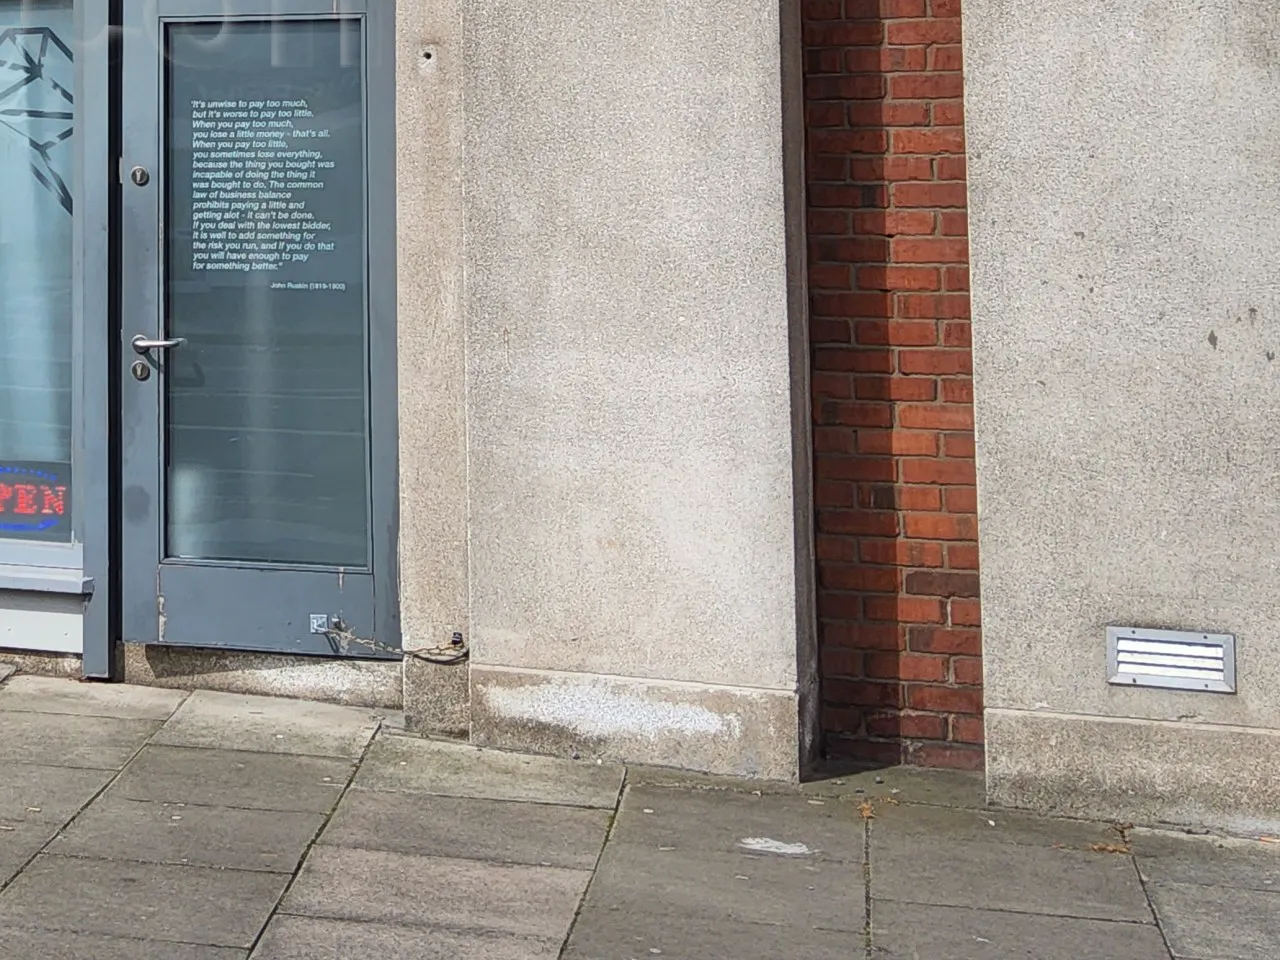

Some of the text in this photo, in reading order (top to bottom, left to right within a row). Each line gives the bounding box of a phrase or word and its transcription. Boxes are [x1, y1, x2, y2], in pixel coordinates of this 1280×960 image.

[208, 100, 236, 108] unwise
[239, 100, 247, 108] to
[249, 101, 265, 109] pay
[266, 100, 280, 108] too
[192, 110, 206, 118] but
[250, 110, 258, 118] to
[260, 111, 276, 119] pay
[192, 120, 215, 128] When
[217, 121, 233, 130] you
[235, 121, 251, 129] pay
[252, 120, 266, 128] too
[193, 131, 209, 140] you
[210, 130, 227, 138] lose
[236, 130, 254, 138] little
[256, 131, 285, 139] money
[192, 140, 215, 148] When
[217, 141, 233, 150] you
[235, 141, 251, 149] pay
[252, 140, 266, 148] too
[193, 151, 209, 160] you
[210, 150, 255, 158] sometimes
[257, 150, 275, 158] lose
[192, 160, 228, 168] because
[230, 160, 243, 168] the
[245, 160, 266, 169] thing
[268, 161, 284, 170] you
[285, 160, 316, 169] bought
[192, 170, 233, 180] incapable
[235, 170, 244, 178] of
[245, 170, 269, 180] doing
[286, 170, 308, 179] thing
[310, 170, 316, 178] it
[211, 181, 241, 190] bought
[192, 191, 292, 199] law of business balance
[193, 201, 229, 210] prohibits
[231, 201, 259, 210] paying
[269, 201, 287, 209] little
[288, 201, 305, 209] and
[192, 211, 222, 220] getting
[224, 211, 240, 219] alot
[247, 211, 253, 219] it
[278, 211, 289, 219] be
[192, 221, 199, 229] If
[200, 222, 216, 230] you
[218, 221, 236, 229] deal
[237, 221, 255, 229] with
[257, 221, 271, 229] the
[272, 221, 300, 229] lowest
[200, 231, 207, 239] is
[210, 231, 226, 239] well
[228, 231, 237, 239] to
[238, 231, 255, 239] add
[256, 231, 301, 241] something
[303, 232, 316, 240] for
[225, 243, 240, 251] you
[286, 243, 302, 252] you
[303, 242, 316, 250] do
[317, 242, 335, 250] that
[193, 251, 309, 262] you will have enough to pay
[192, 261, 205, 269] for
[206, 261, 250, 271] something
